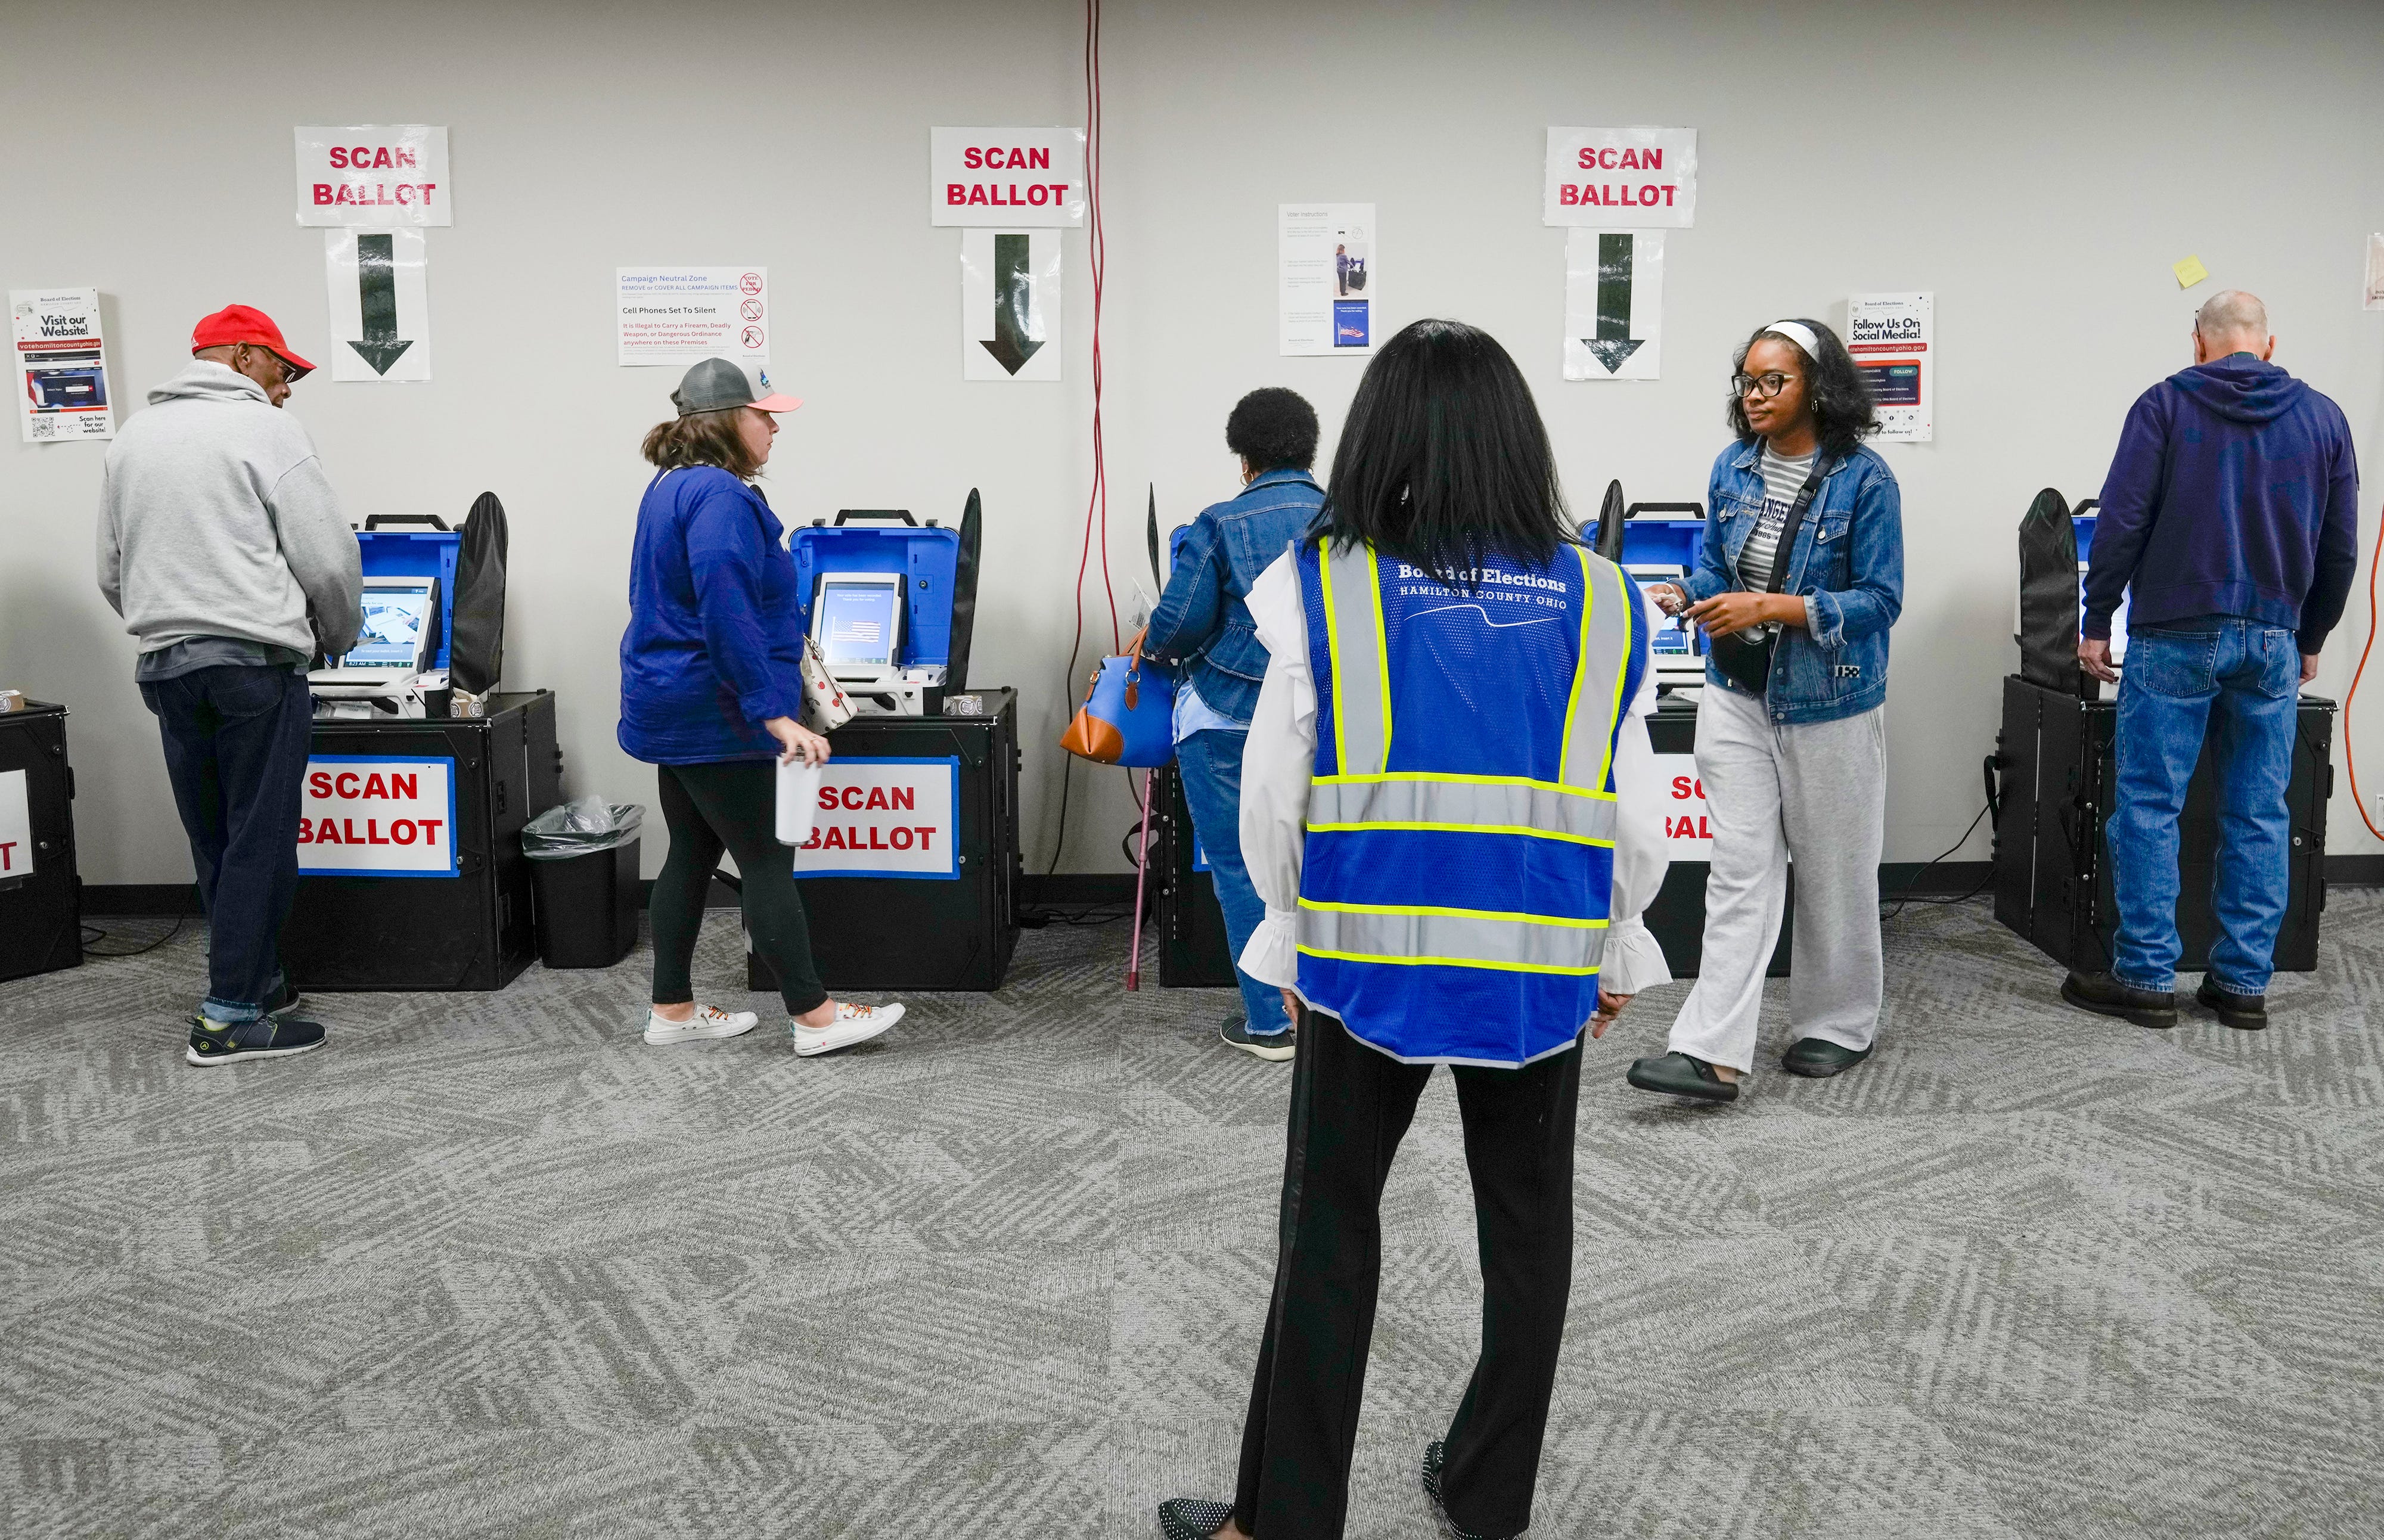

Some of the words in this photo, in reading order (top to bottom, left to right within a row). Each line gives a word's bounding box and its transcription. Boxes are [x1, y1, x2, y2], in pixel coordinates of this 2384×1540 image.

[330, 147, 416, 169] SCAN
[964, 147, 1049, 169] SCAN
[1578, 148, 1663, 170] SCAN
[313, 184, 436, 206] BALLOT
[947, 184, 1068, 206] BALLOT
[1560, 184, 1681, 206] BALLOT
[41, 315, 67, 325] Visit
[69, 316, 86, 325] our
[41, 324, 89, 337] Website!
[1853, 319, 1885, 329] Follow
[1887, 318, 1900, 328] Us
[1902, 318, 1920, 328] On
[20, 340, 101, 349] votehamiltoncountyohio.gov
[1852, 329, 1880, 340] Social
[1882, 328, 1921, 340] Media!
[1764, 521, 1783, 534] Ang
[1459, 567, 1478, 582] of
[1481, 568, 1566, 593] Elections
[1400, 586, 1470, 598] HAMILTON
[1476, 589, 1531, 603] COUNTY
[1536, 595, 1567, 609] OHIO
[309, 772, 417, 799] SCAN
[818, 786, 914, 811] SCAN
[298, 818, 443, 845] BALLOT
[800, 826, 936, 850] BALLOT
